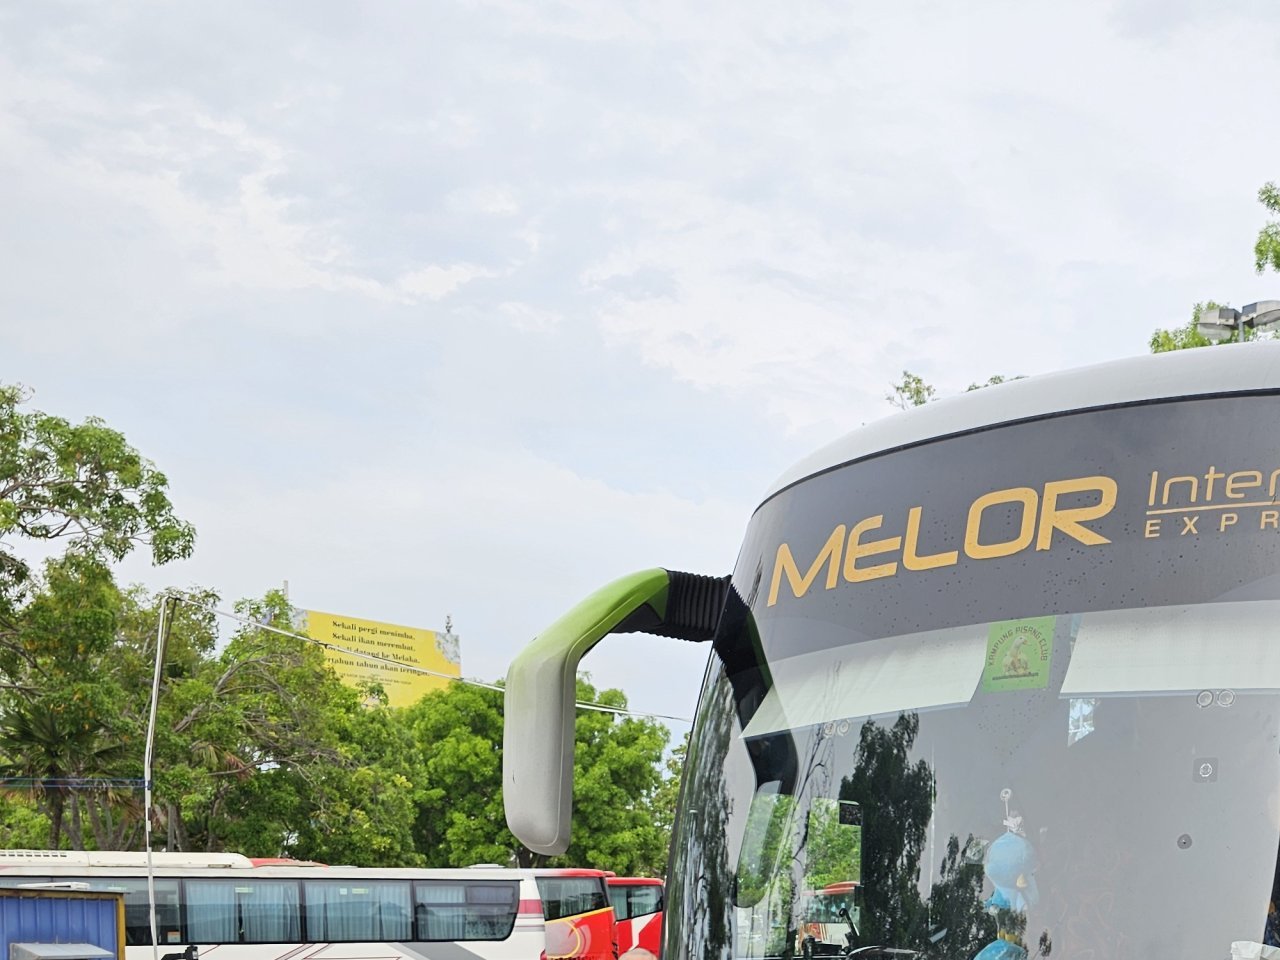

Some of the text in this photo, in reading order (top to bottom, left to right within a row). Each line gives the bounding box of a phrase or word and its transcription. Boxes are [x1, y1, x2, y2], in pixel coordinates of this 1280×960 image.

[767, 476, 1118, 607] MELOR
[332, 620, 357, 631] Sekali
[358, 625, 378, 635] pergi
[332, 632, 357, 643] Sekali
[358, 636, 375, 645] ikan
[1038, 638, 1049, 661] CLUB
[356, 661, 379, 669] tahun
[380, 664, 399, 672] akan
